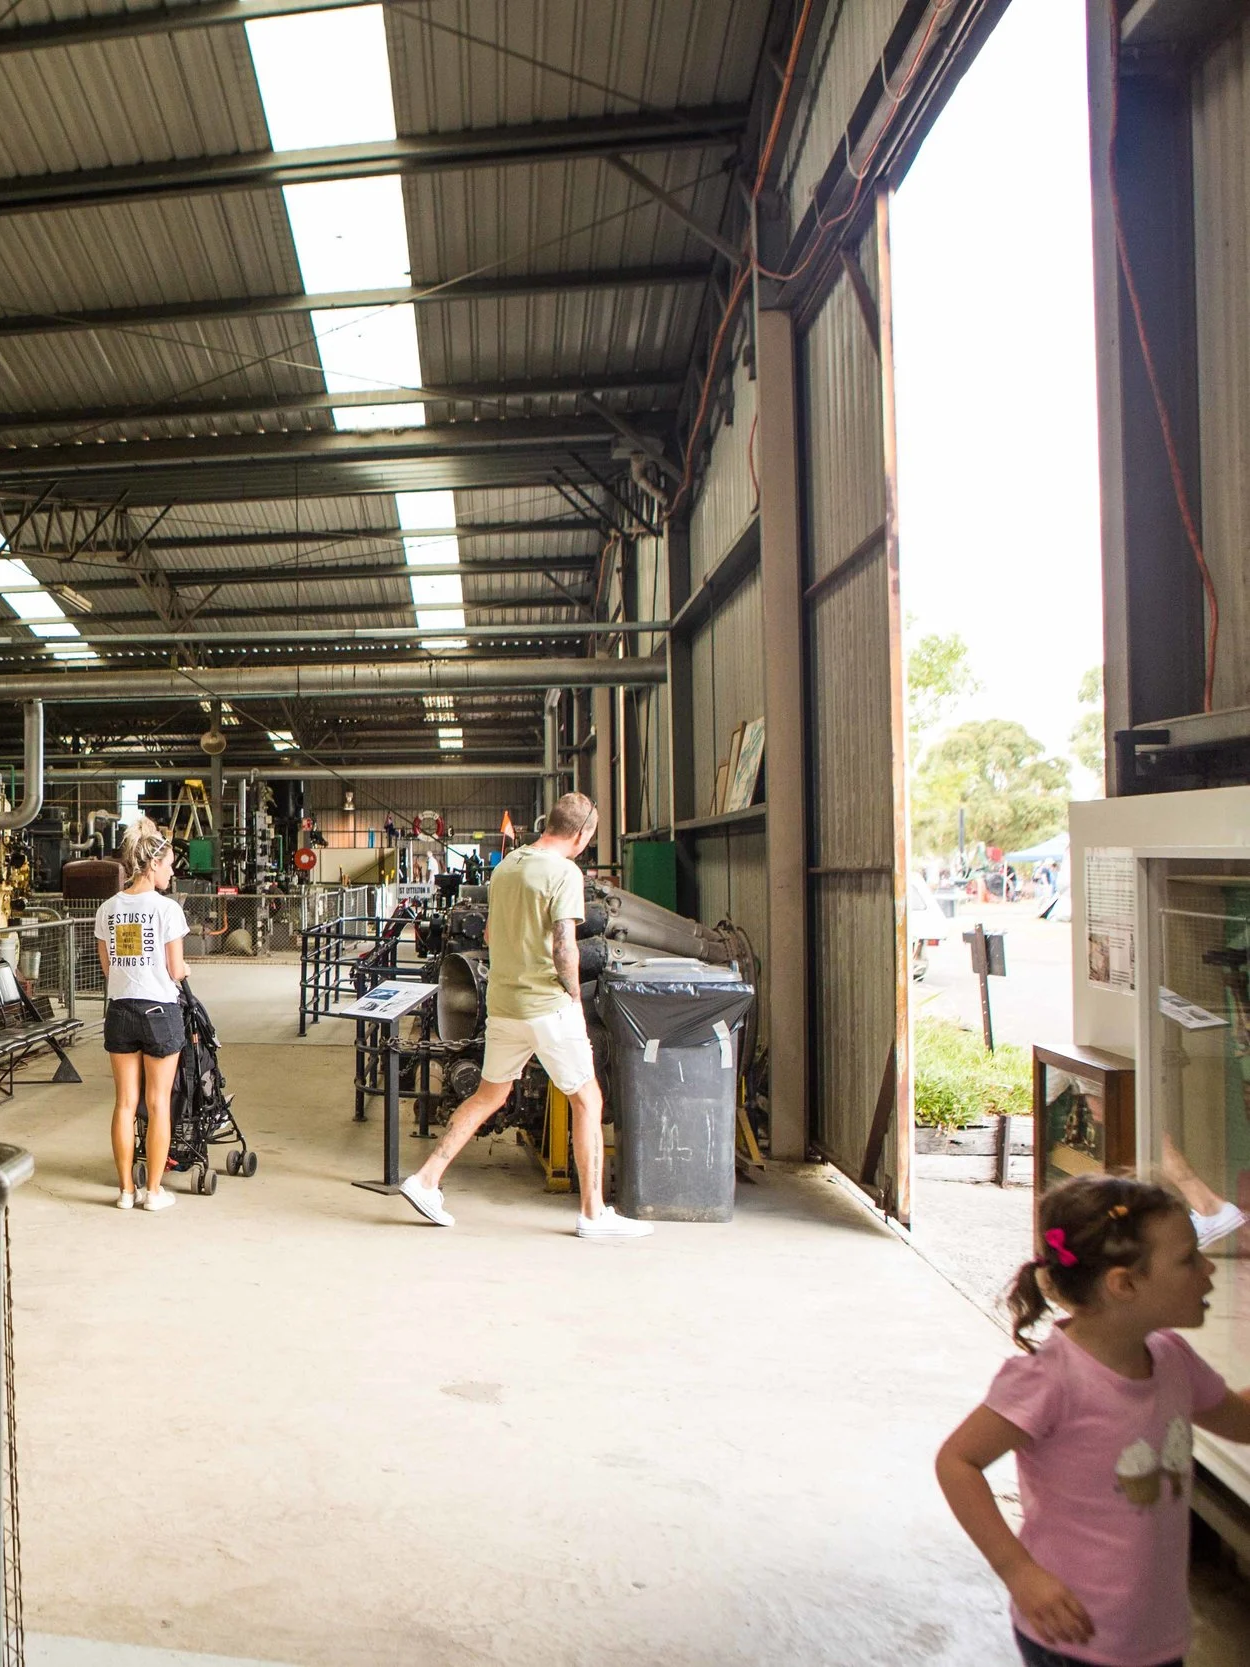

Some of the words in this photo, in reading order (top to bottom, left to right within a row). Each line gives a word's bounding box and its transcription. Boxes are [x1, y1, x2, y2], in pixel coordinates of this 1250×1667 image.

[116, 913, 154, 924] STUSSY
[143, 928, 154, 952] 1980
[140, 957, 154, 966] ST.
